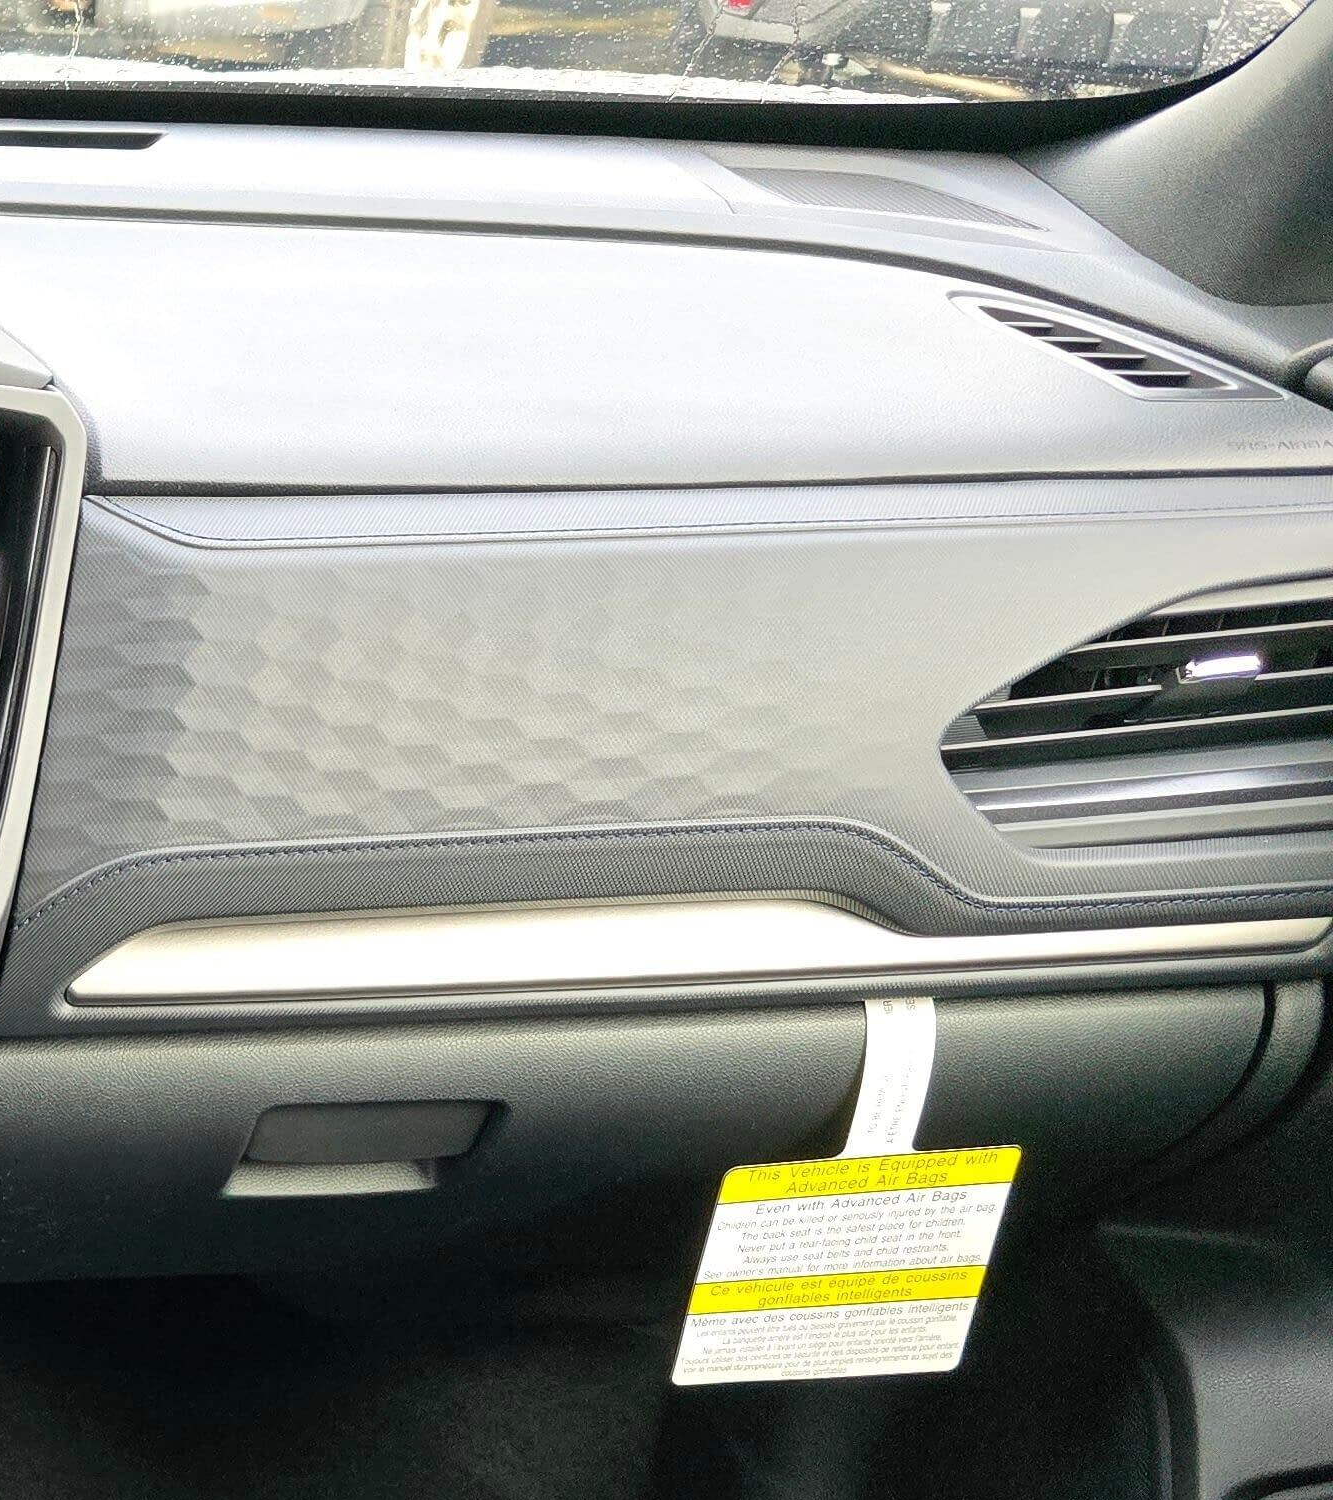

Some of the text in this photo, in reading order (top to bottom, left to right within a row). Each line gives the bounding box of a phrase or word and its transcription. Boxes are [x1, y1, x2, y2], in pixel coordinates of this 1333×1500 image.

[746, 1151, 999, 1181] This Vehicle is Equipped with
[785, 1169, 949, 1192] Advanced Air Bags
[755, 1188, 968, 1214] Even with Advanced Air Bags
[760, 1219, 778, 1227] can
[781, 1216, 795, 1225] be
[887, 1208, 921, 1220] injured
[923, 1207, 936, 1217] by
[939, 1205, 956, 1214] the
[958, 1204, 973, 1213] air
[736, 1243, 766, 1252] Never
[768, 1241, 785, 1252] put
[854, 1235, 878, 1244] child
[880, 1233, 902, 1242] seat
[905, 1232, 915, 1240] in
[918, 1231, 934, 1239] the
[741, 1231, 758, 1240] The
[789, 1228, 811, 1237] seat
[814, 1227, 823, 1235] is
[826, 1225, 842, 1234] the
[845, 1223, 876, 1233] safest
[877, 1221, 905, 1232] place
[908, 1220, 922, 1228] for
[702, 1270, 722, 1279] See
[766, 1264, 803, 1274] manual
[805, 1263, 820, 1272] for
[851, 1257, 906, 1269] information
[908, 1255, 937, 1265] about
[939, 1254, 953, 1263] air
[742, 1254, 777, 1265] Always
[802, 1251, 824, 1260] seat
[853, 1247, 873, 1256] and
[875, 1245, 899, 1255] child
[709, 1284, 731, 1295] Ce
[735, 1280, 795, 1294] véhicule
[799, 1278, 822, 1289] est
[881, 1273, 900, 1284] de
[905, 1269, 969, 1283] coussins
[757, 1285, 914, 1307] gonflables intelligents
[731, 1316, 758, 1324] avec
[762, 1313, 785, 1322] des
[788, 1309, 840, 1320] coussins
[843, 1305, 904, 1319] gonflables
[906, 1301, 970, 1316] intelligents
